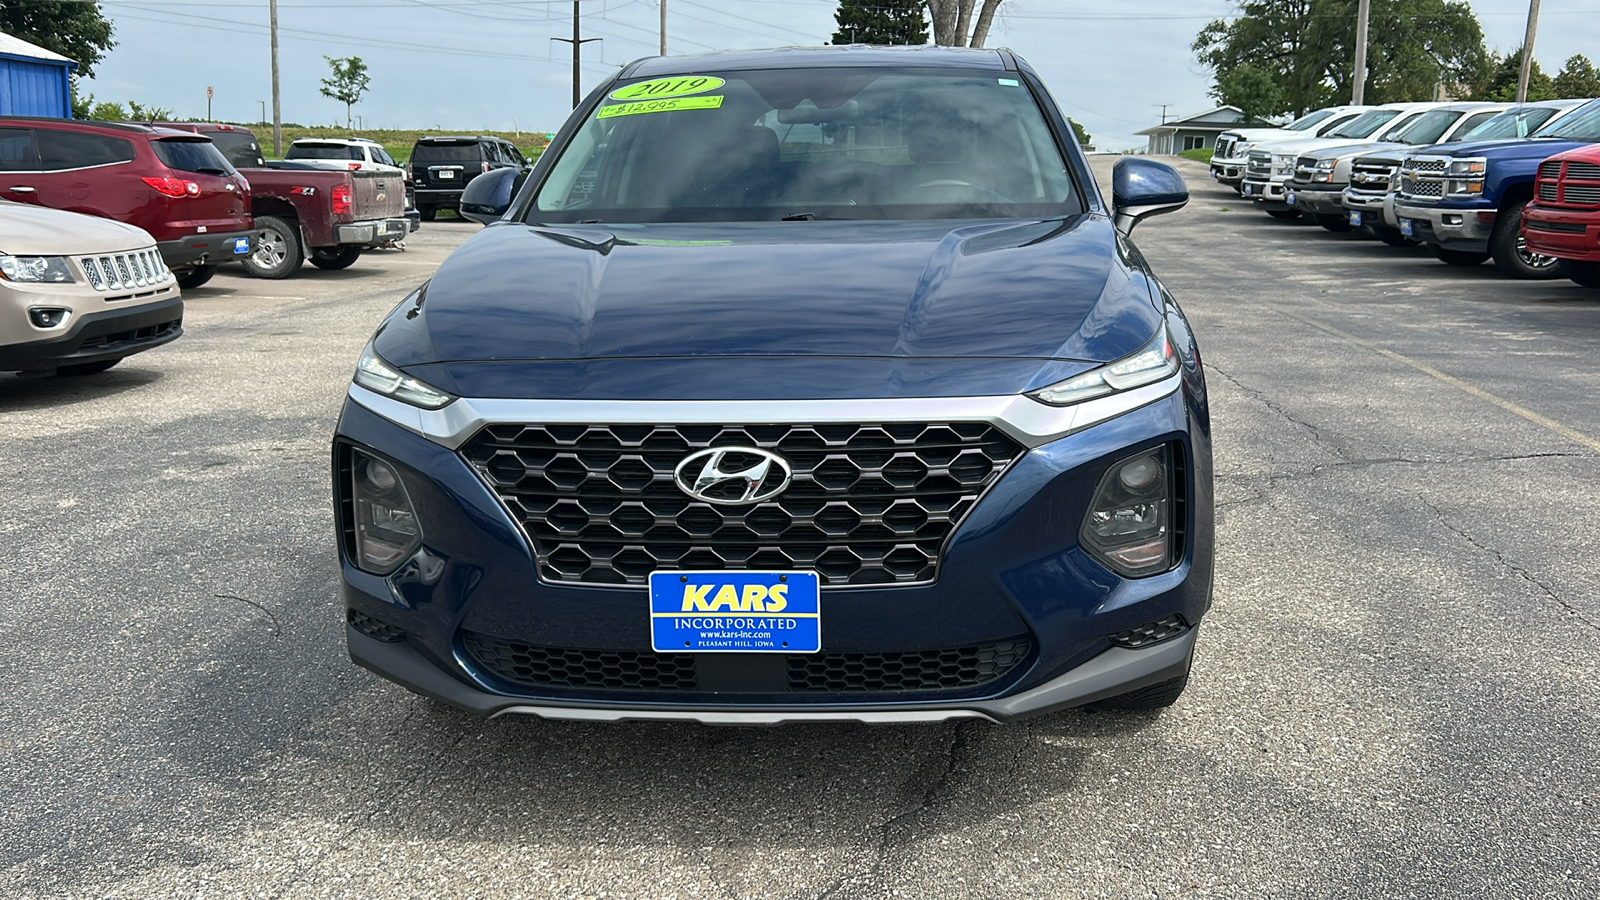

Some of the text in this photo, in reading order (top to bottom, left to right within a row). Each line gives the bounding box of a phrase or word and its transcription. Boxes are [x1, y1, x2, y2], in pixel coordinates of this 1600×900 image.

[627, 78, 708, 98] 2019
[615, 100, 680, 115] $12,995
[681, 583, 789, 612] KARS
[674, 618, 797, 630] INCORPORATED
[700, 630, 771, 639] www.kars-inc.com
